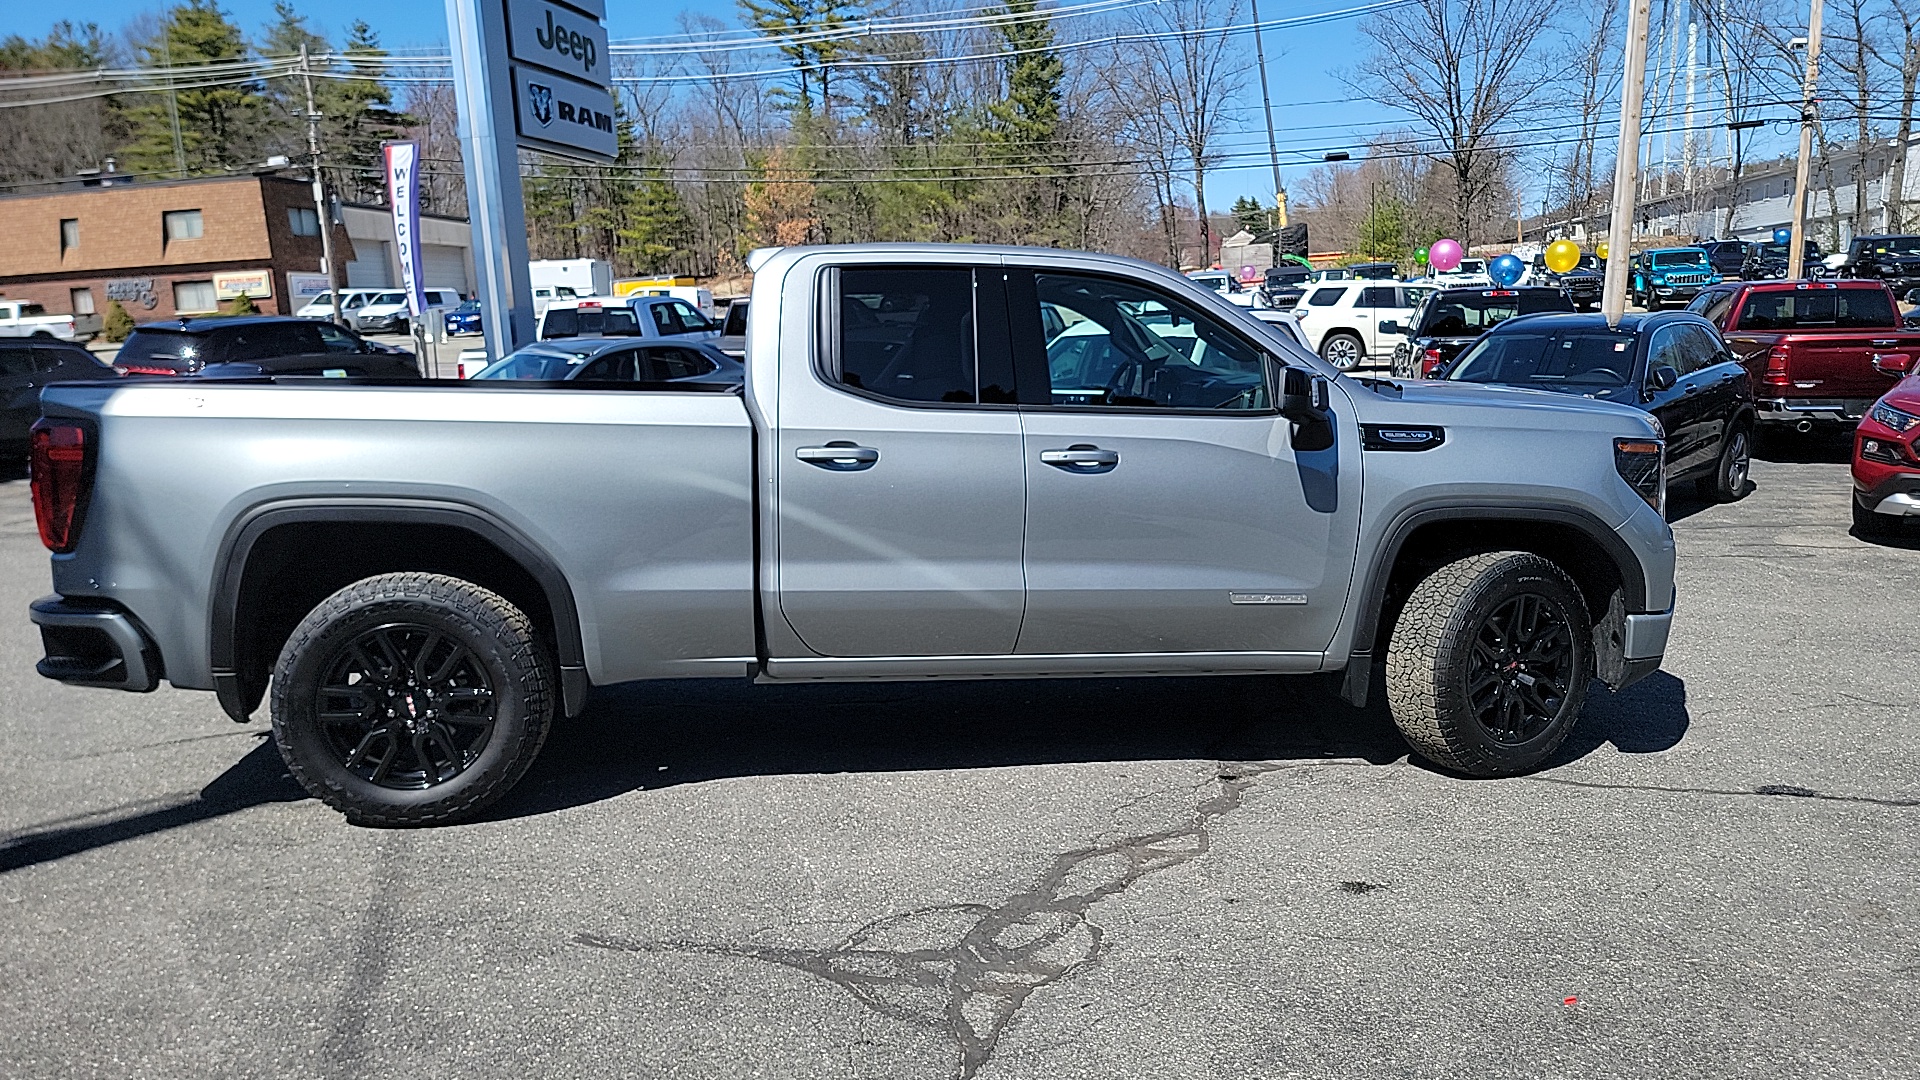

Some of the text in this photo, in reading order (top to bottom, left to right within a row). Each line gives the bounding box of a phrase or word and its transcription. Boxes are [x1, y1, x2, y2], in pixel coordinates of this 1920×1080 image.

[536, 9, 597, 72] Jeep
[557, 100, 613, 134] RAM
[394, 168, 412, 294] WELCOME
